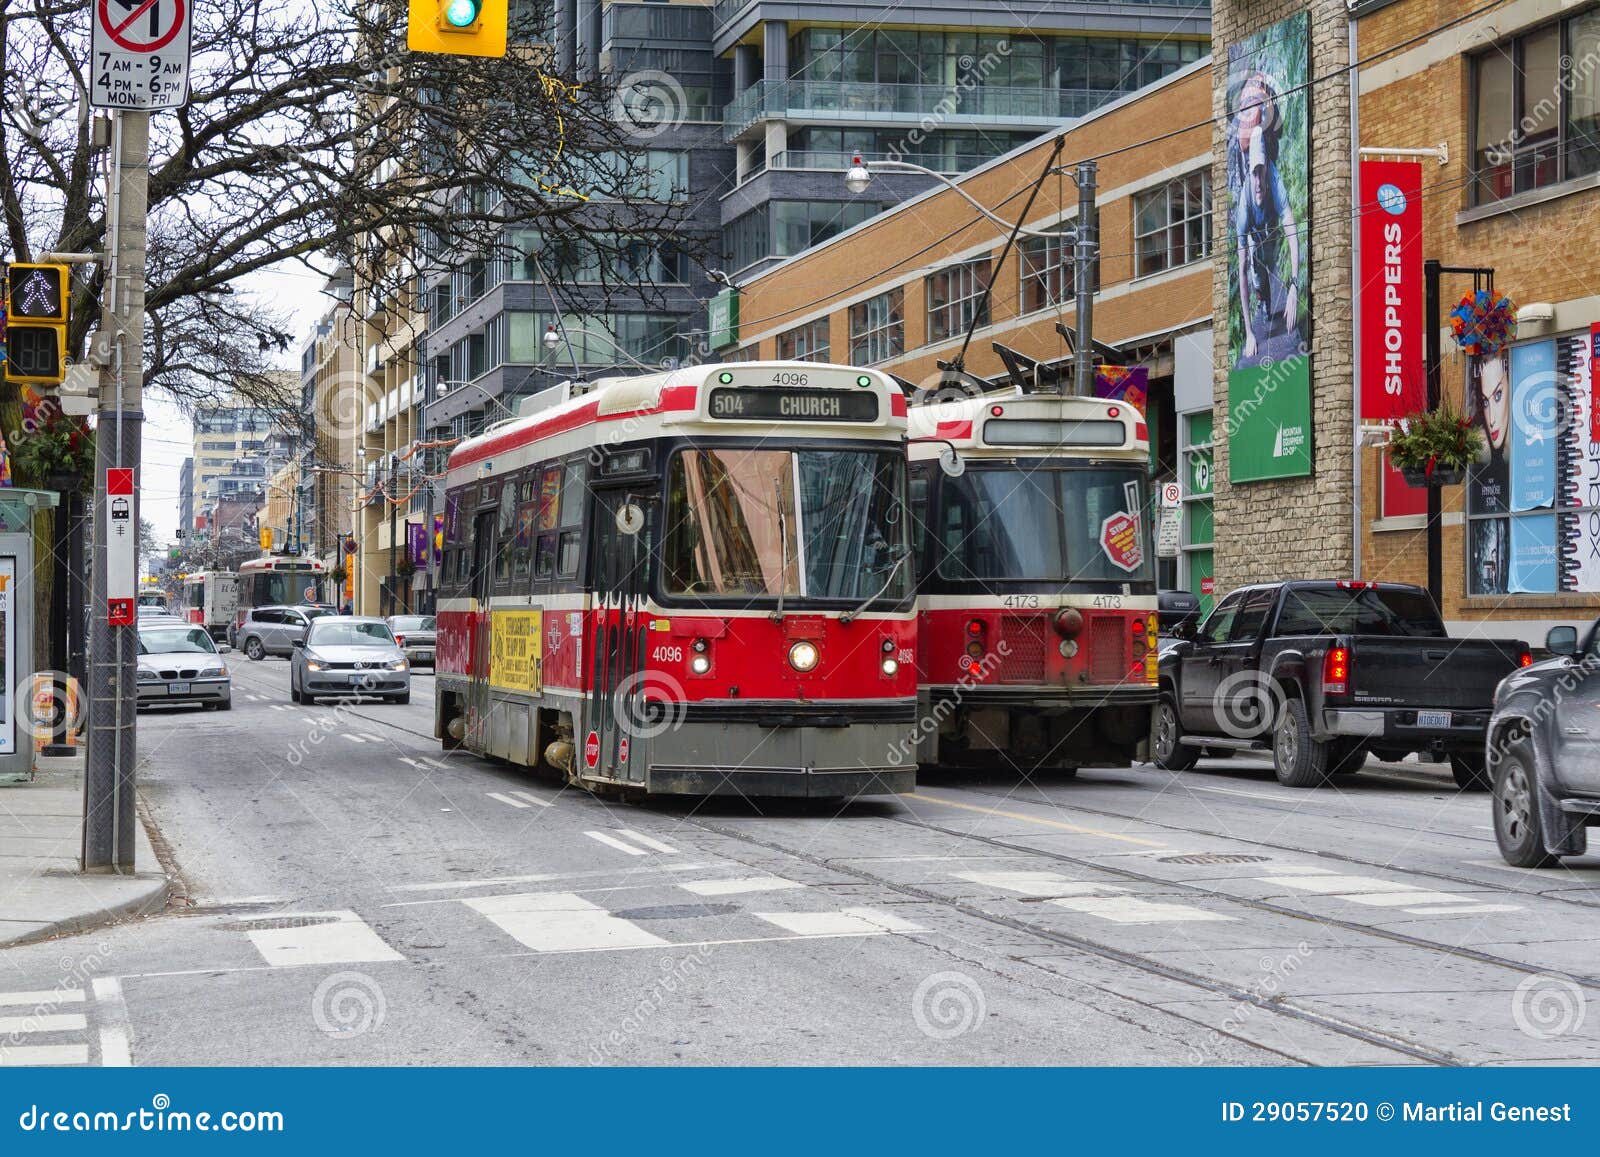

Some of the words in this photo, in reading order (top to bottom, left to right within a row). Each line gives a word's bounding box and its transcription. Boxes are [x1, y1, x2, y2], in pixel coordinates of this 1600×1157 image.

[107, 91, 136, 105] MON
[151, 93, 170, 105] FRI
[1385, 222, 1401, 395] SHOPPERS
[772, 373, 808, 386] 4096
[714, 395, 744, 414] 504
[780, 396, 840, 416] CHURCH
[1003, 595, 1039, 609] 4173
[1093, 595, 1122, 609] 4173
[652, 646, 682, 662] 4096
